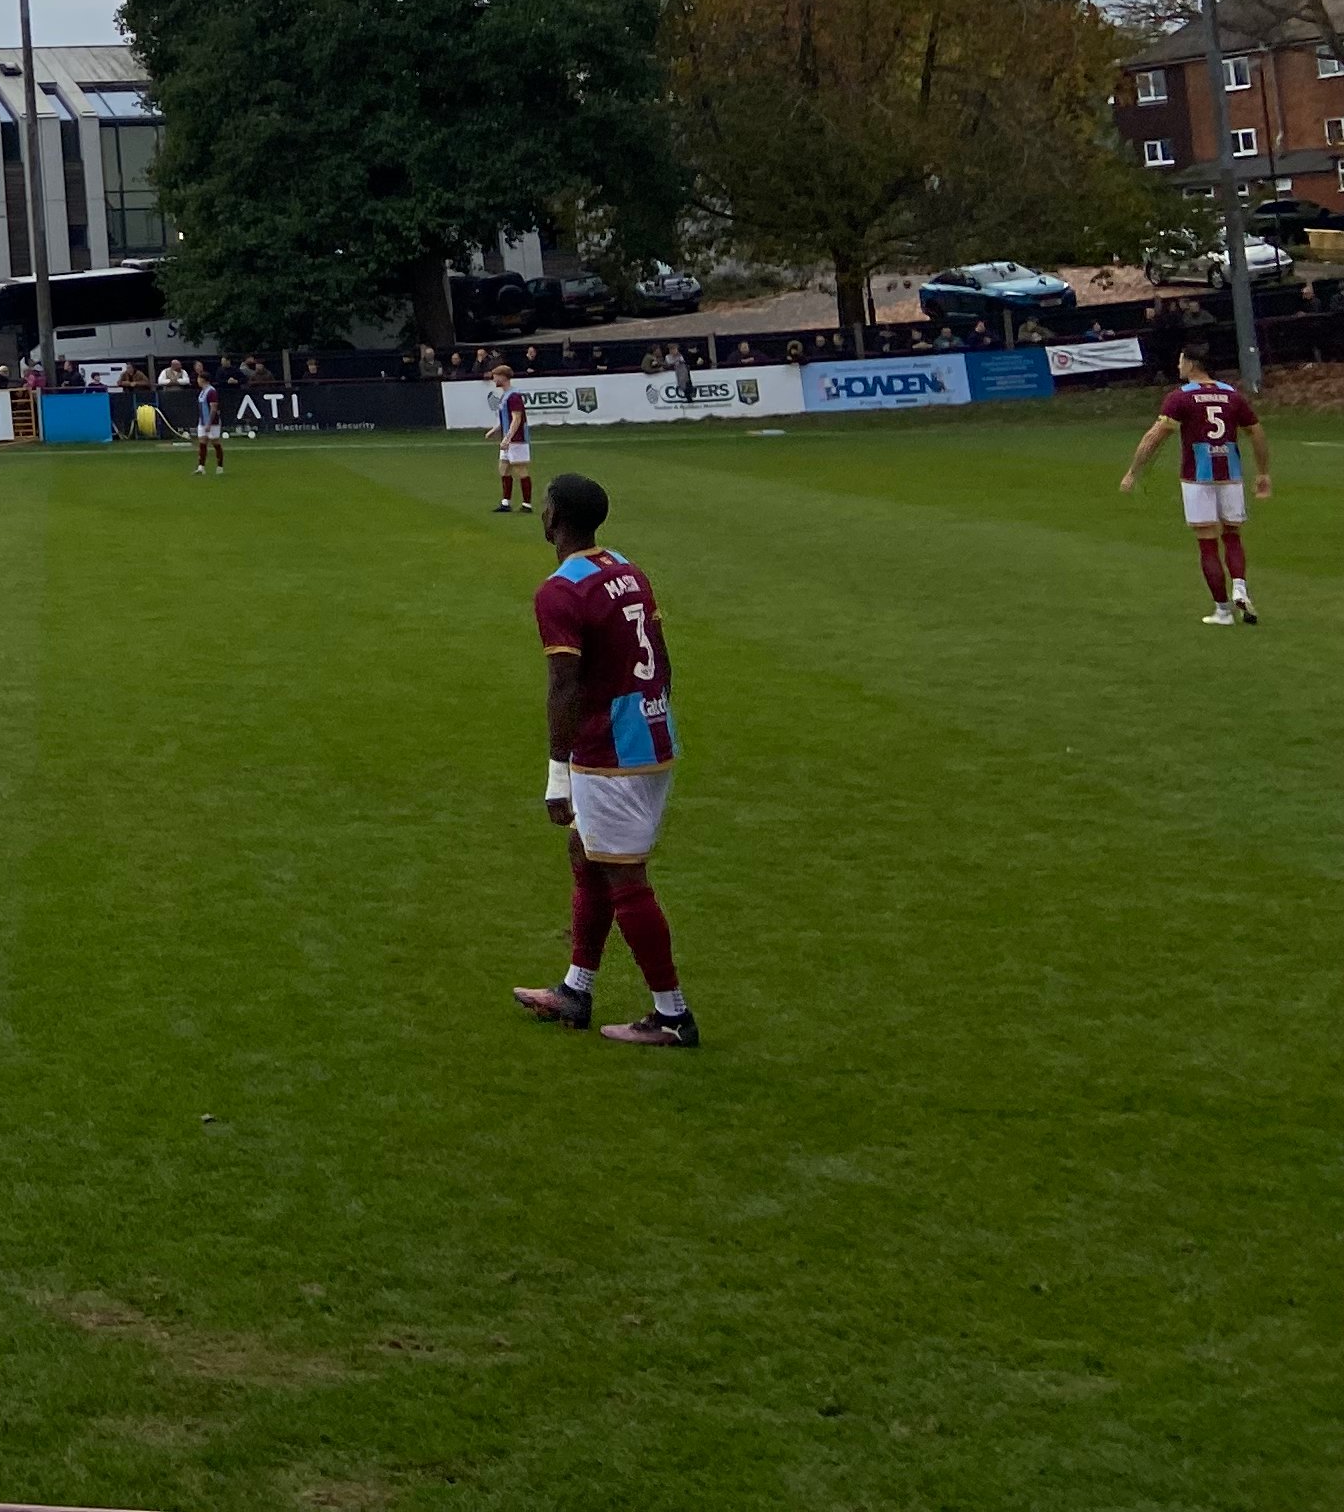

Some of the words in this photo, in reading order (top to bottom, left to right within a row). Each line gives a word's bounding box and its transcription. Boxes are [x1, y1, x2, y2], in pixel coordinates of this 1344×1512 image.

[274, 423, 320, 431] Electrical
[336, 422, 376, 430] Security
[1206, 405, 1226, 440] 5
[622, 603, 656, 680] 3
